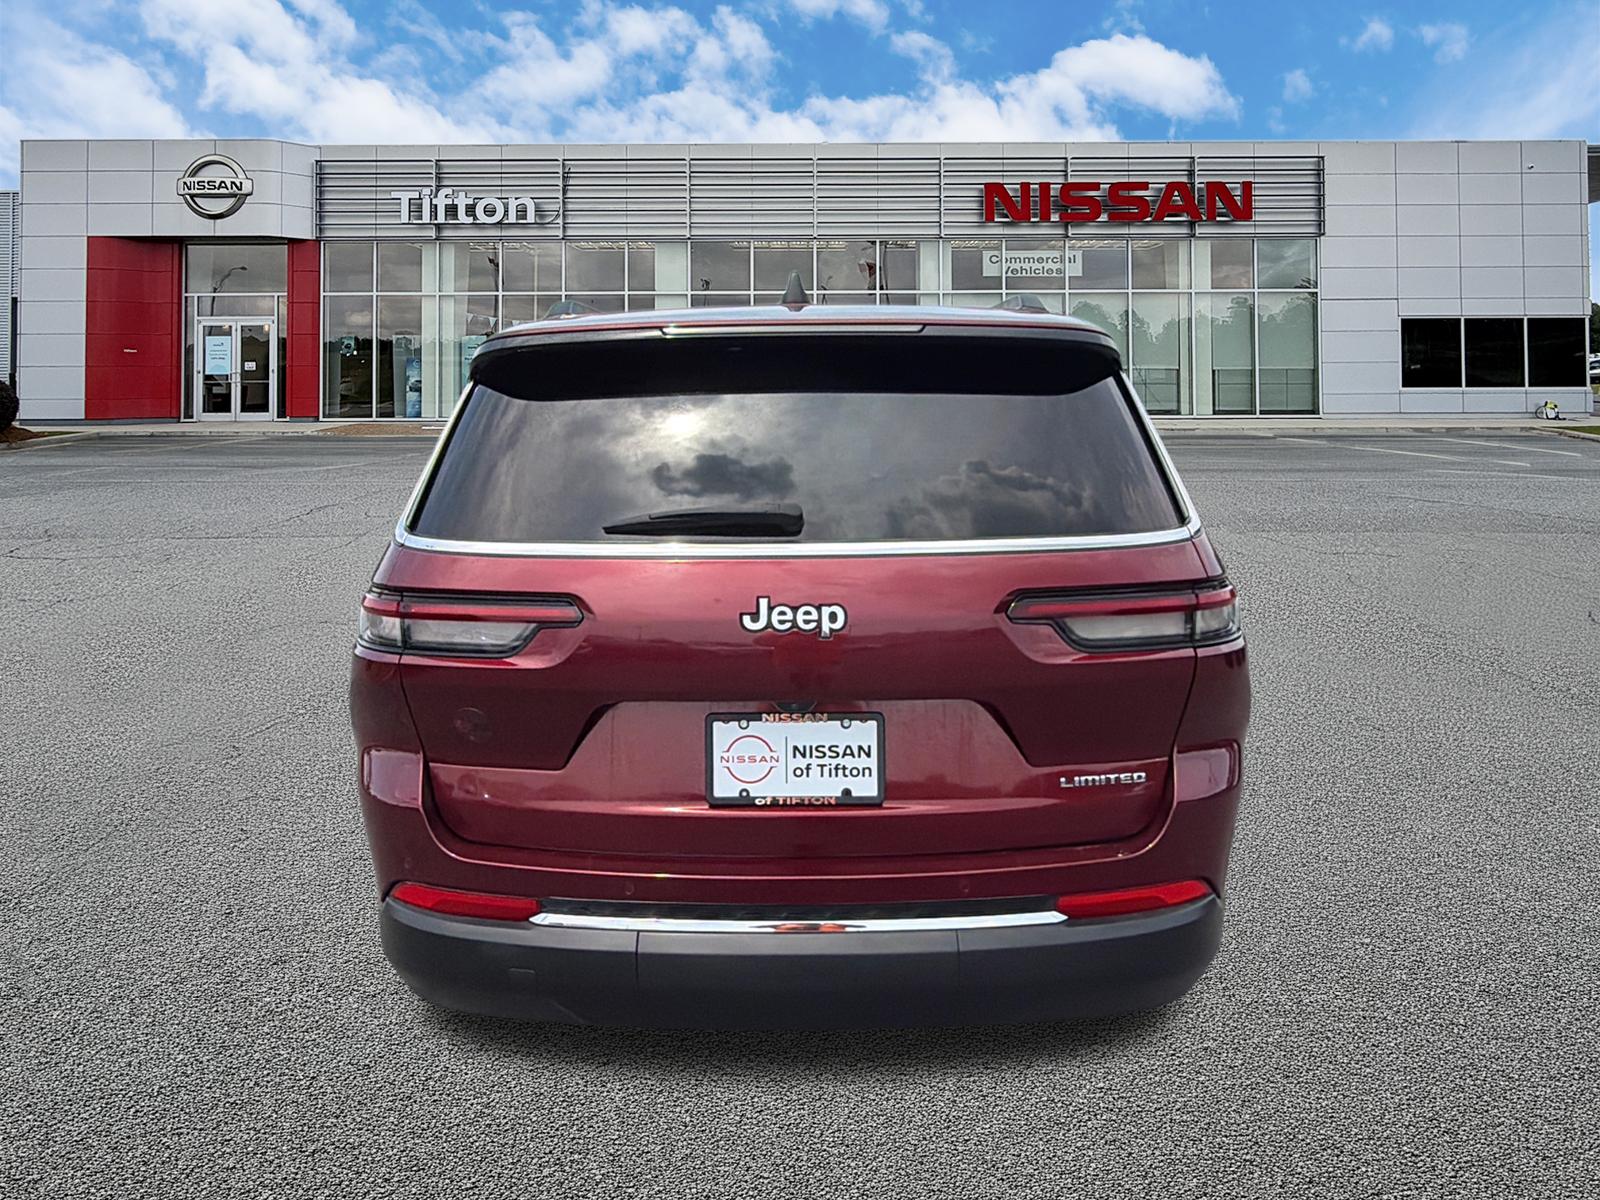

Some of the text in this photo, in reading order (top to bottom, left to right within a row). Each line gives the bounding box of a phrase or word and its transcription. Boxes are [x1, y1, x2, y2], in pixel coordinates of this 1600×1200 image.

[182, 180, 243, 191] NISSAN
[390, 188, 537, 225] Tifton
[983, 181, 1254, 222] NISSAN
[741, 596, 847, 637] Jeep
[761, 713, 828, 723] NISSAN
[792, 744, 872, 759] NISSAN
[720, 755, 780, 764] NISSAN
[792, 764, 872, 778] of Tifton
[1059, 772, 1147, 788] LIMITED
[754, 796, 837, 806] of TIFTON
